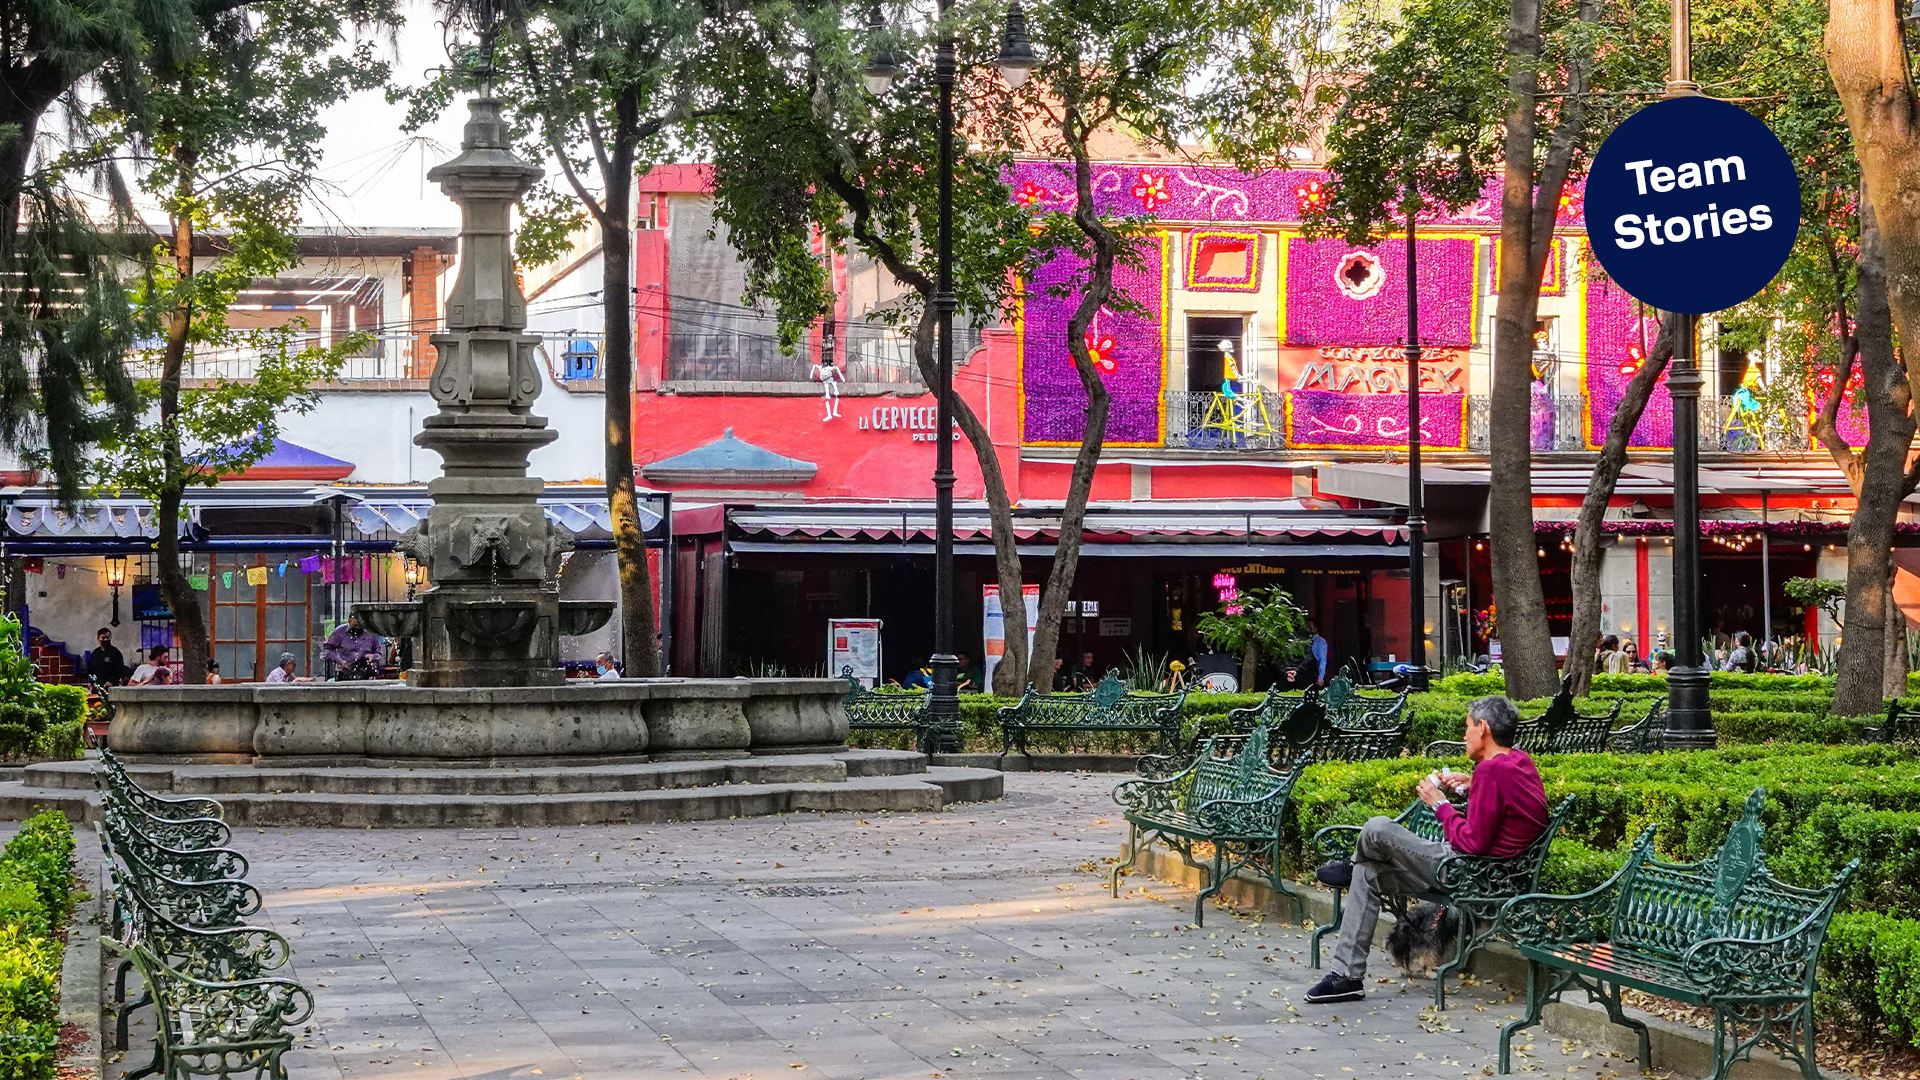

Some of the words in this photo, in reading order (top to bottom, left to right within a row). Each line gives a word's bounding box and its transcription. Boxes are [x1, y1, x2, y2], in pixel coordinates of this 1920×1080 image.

[1293, 362, 1464, 393] MAGUEY
[859, 416, 869, 430] LA
[872, 406, 959, 430] CERVECEA
[912, 433, 925, 442] DE
